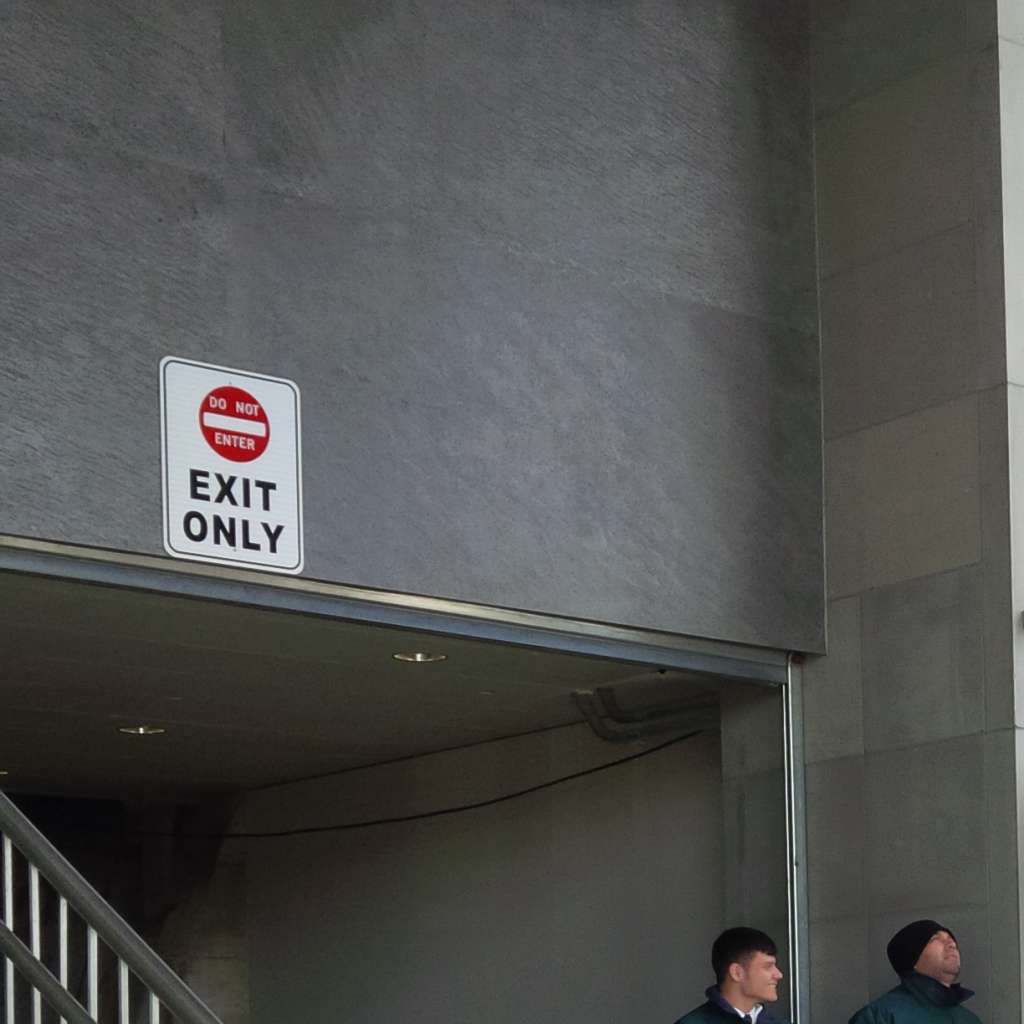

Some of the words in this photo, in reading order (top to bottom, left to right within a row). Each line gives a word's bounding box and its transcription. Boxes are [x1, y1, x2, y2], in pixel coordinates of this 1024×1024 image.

[209, 395, 227, 410] DO
[235, 400, 259, 416] NOT
[215, 431, 255, 451] ENTER
[189, 468, 277, 512] EXIT
[183, 510, 284, 554] ONLY
